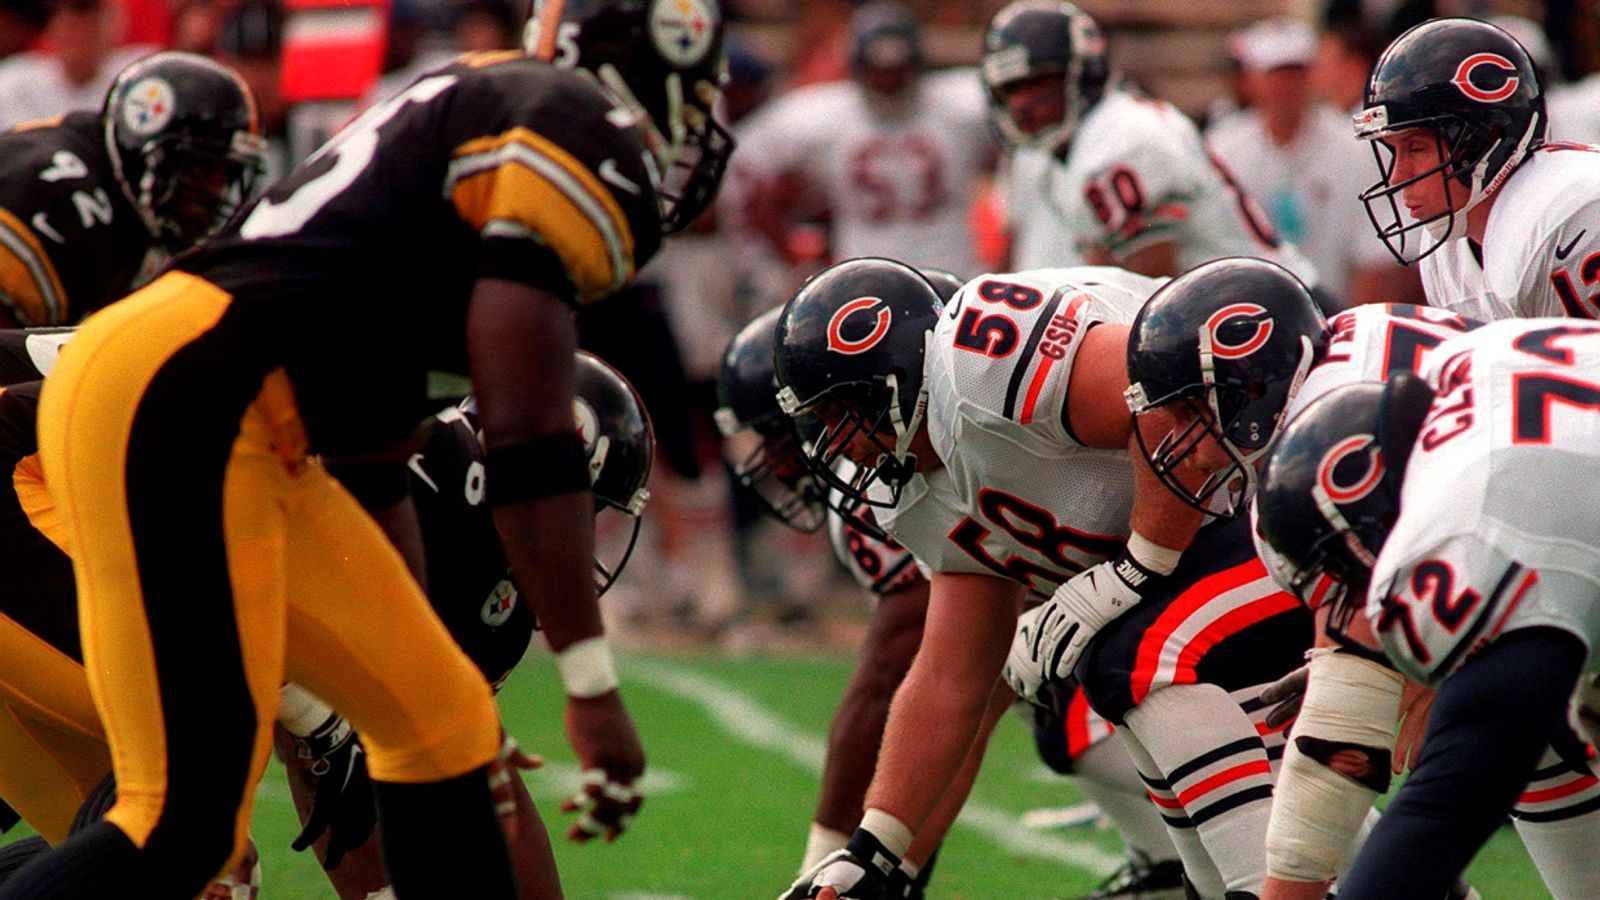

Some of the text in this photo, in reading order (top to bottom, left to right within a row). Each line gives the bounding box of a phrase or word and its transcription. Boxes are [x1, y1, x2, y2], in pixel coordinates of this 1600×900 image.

[1451, 53, 1520, 103] C
[826, 296, 893, 356] C
[952, 279, 1044, 359] 58
[1038, 314, 1079, 361] GSH
[1206, 302, 1275, 360] C
[1317, 434, 1386, 505] C
[947, 486, 1128, 587] 58
[1116, 559, 1149, 588] NIKE
[1376, 560, 1482, 667] 72
